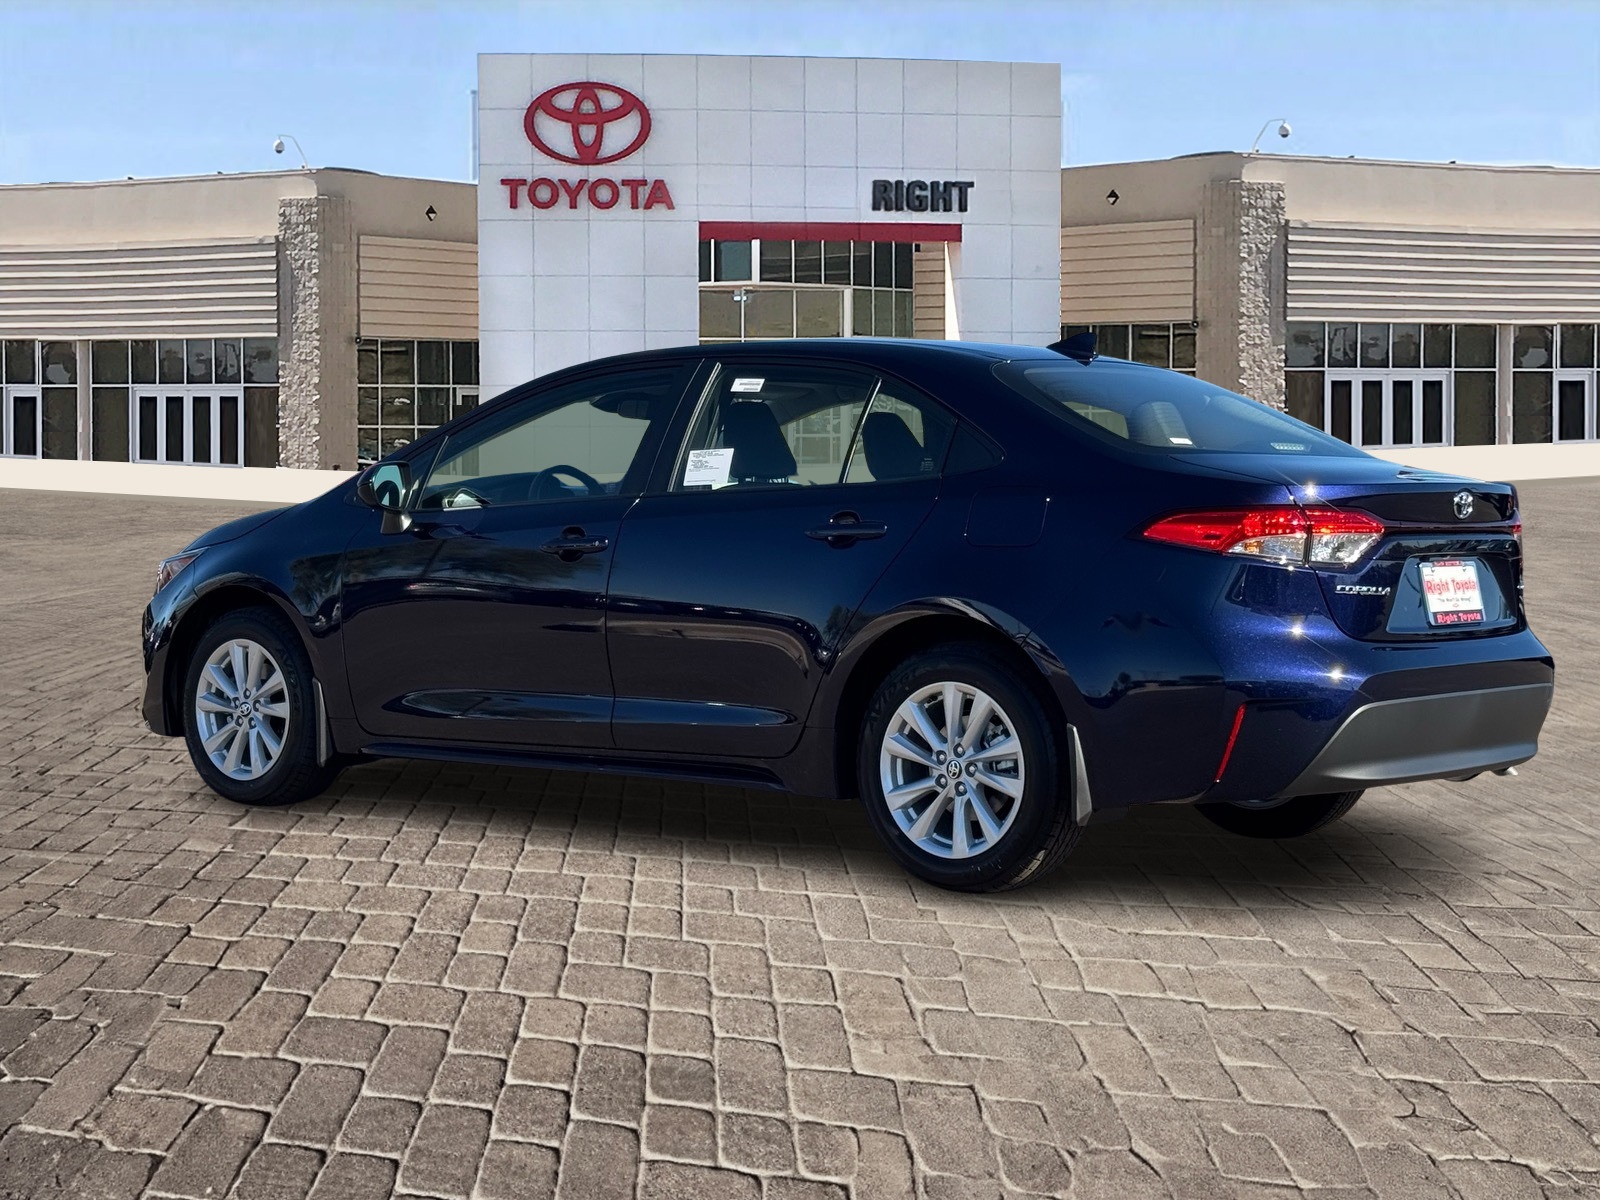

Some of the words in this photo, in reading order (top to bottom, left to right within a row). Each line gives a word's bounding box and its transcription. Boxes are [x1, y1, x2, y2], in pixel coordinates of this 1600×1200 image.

[500, 177, 675, 210] TOYOTA
[872, 179, 975, 212] RIGHT
[1425, 579, 1449, 595] Right
[1451, 577, 1477, 594] Toyota
[1437, 613, 1458, 624] Right
[1459, 612, 1481, 622] Toyota
